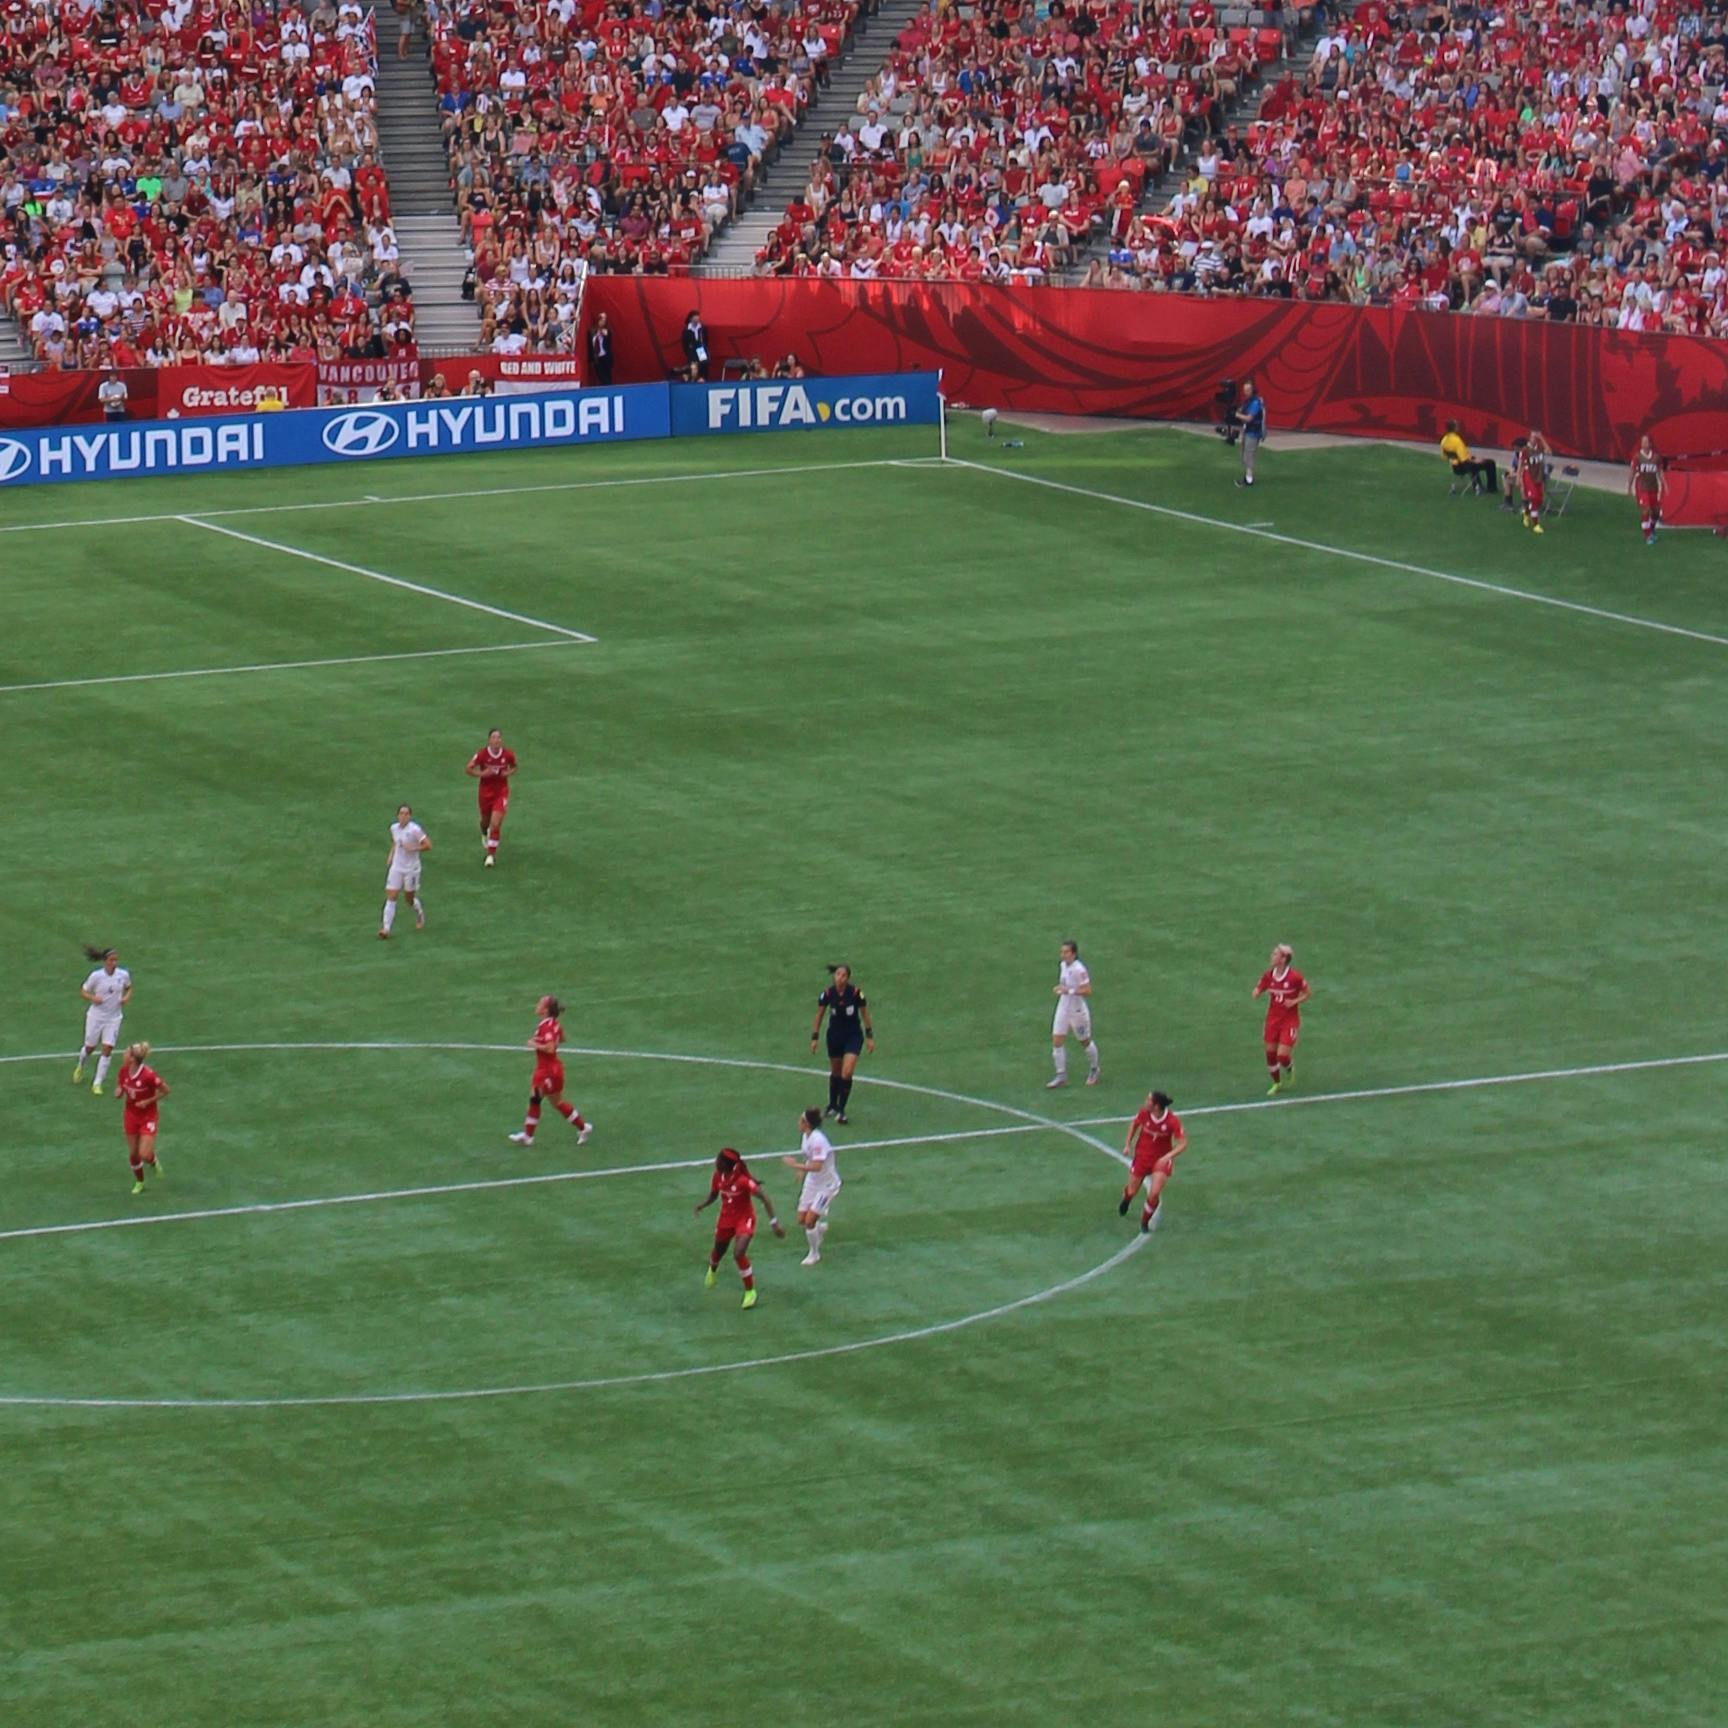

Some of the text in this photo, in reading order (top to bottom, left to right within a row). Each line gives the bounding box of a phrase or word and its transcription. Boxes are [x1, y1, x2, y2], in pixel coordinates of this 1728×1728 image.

[500, 360, 576, 375] RED AND WHITE
[406, 395, 624, 448] HYUNDAI
[708, 385, 906, 429] FIFA.com
[39, 422, 265, 475] HYUNDAI
